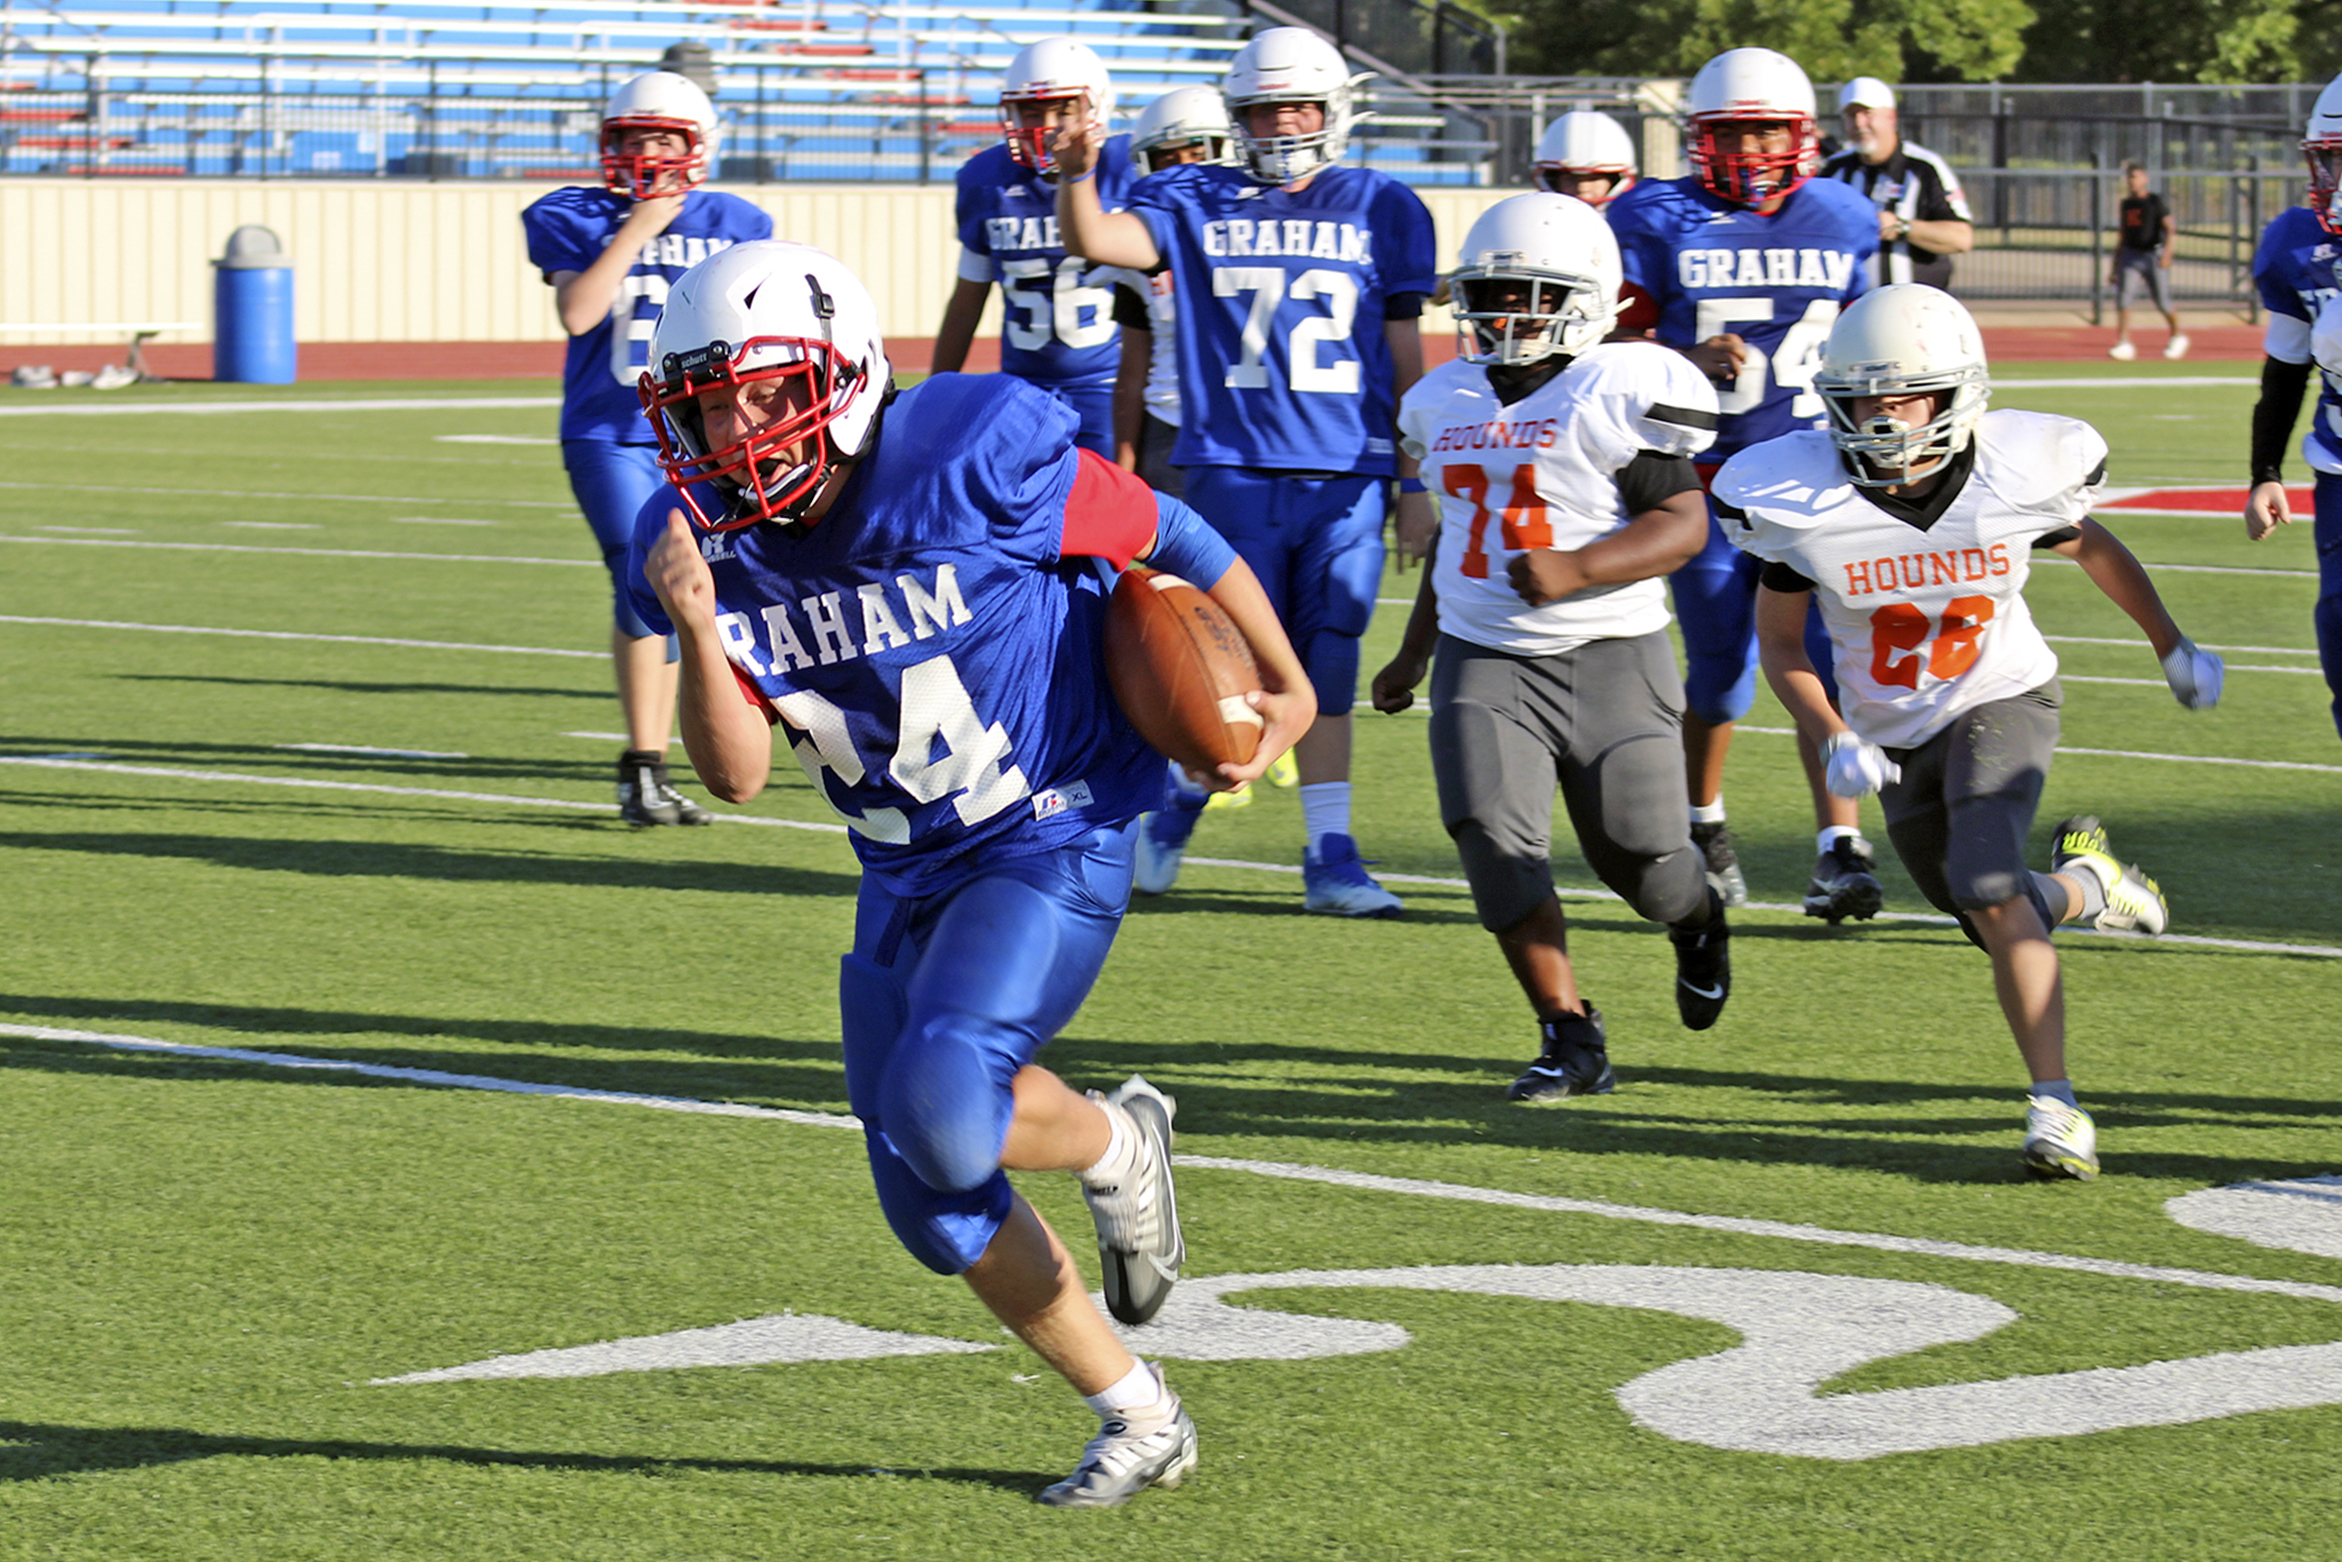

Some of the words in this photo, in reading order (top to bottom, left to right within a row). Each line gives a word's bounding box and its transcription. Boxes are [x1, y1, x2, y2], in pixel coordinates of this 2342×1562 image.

[1203, 219, 1373, 265] GRAHAM
[1678, 248, 1853, 290] GRAHAM
[1002, 255, 1120, 350] 56
[1213, 267, 1360, 393] 72
[681, 352, 708, 369] schutt
[1695, 298, 1840, 418] 54
[1432, 418, 1557, 452] HOUNDS
[1442, 464, 1554, 579] 74
[1844, 543, 2010, 596] HOUNDS
[715, 562, 973, 677] RAHAM
[770, 653, 1033, 846] 24
[1072, 792, 1088, 802] XL
